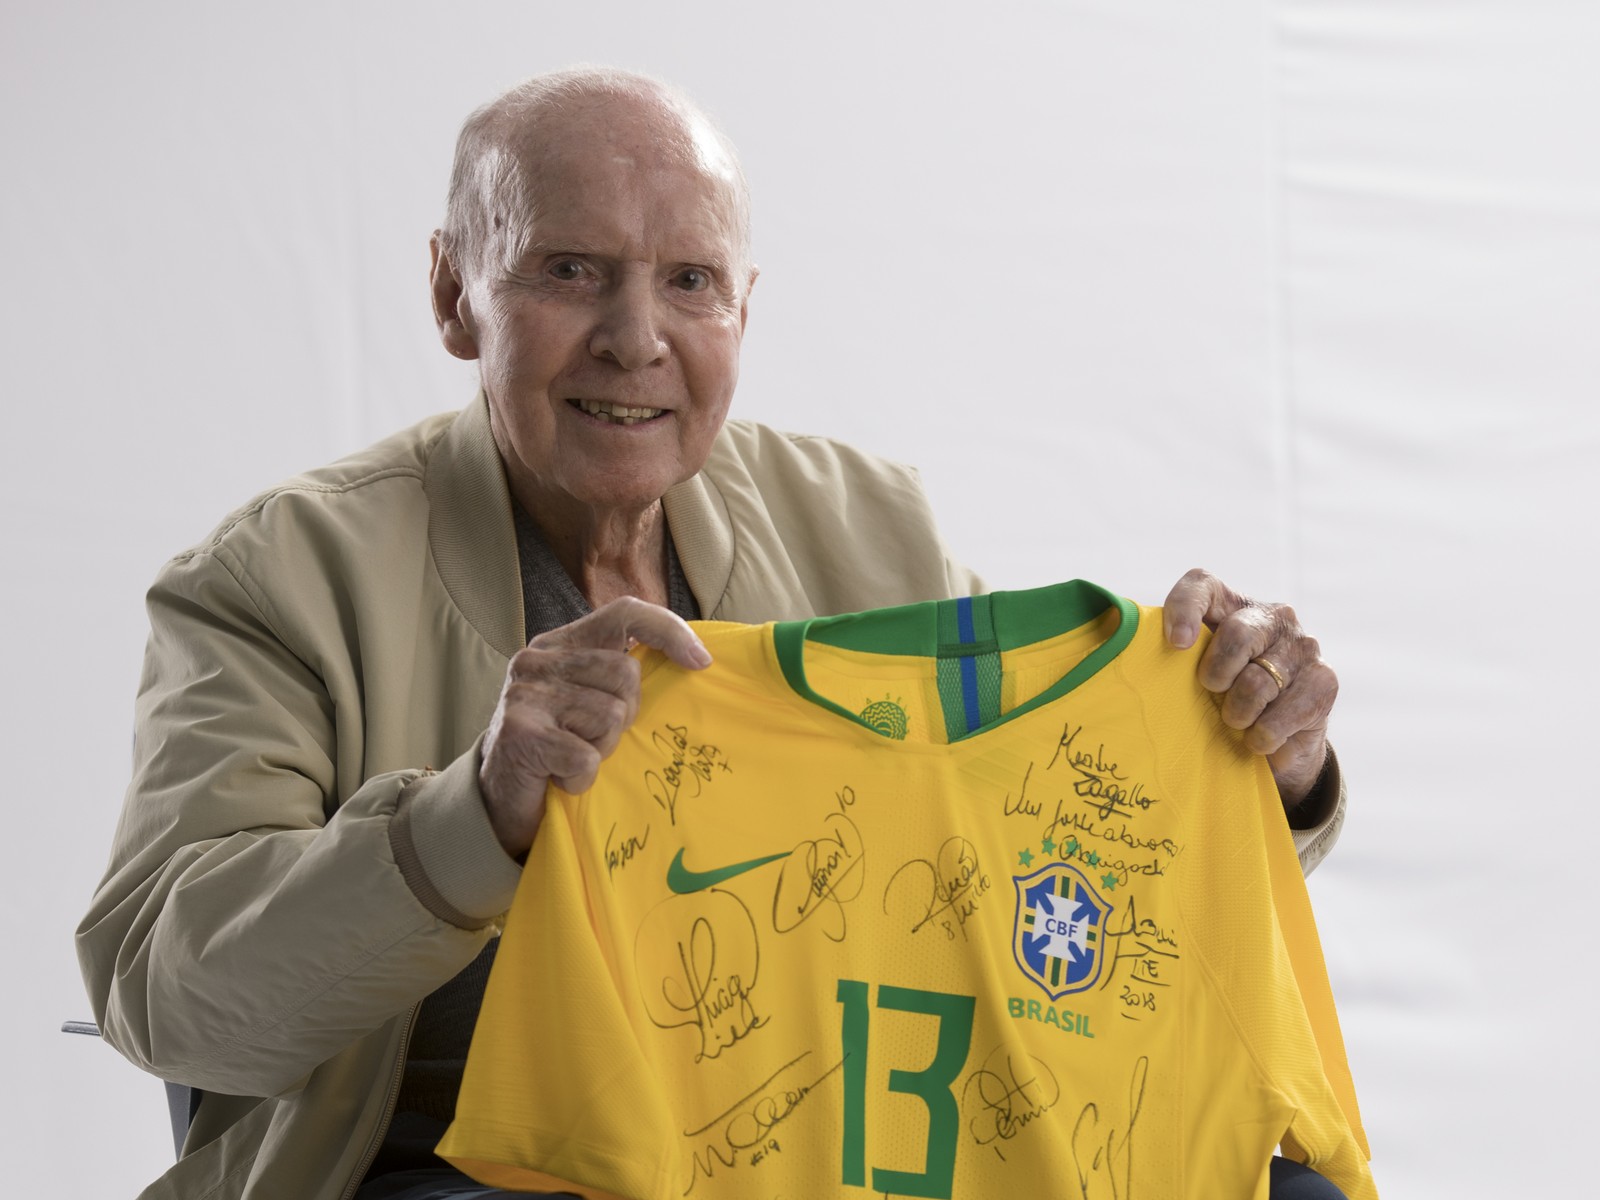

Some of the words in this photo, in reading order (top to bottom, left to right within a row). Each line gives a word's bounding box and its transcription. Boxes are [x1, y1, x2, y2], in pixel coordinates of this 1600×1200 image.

[1073, 777, 1161, 822] Zagallo
[1044, 918, 1078, 938] CBF
[1008, 997, 1095, 1039] BRASIL
[1119, 985, 1156, 1012] 2018
[836, 979, 976, 1200] 13
